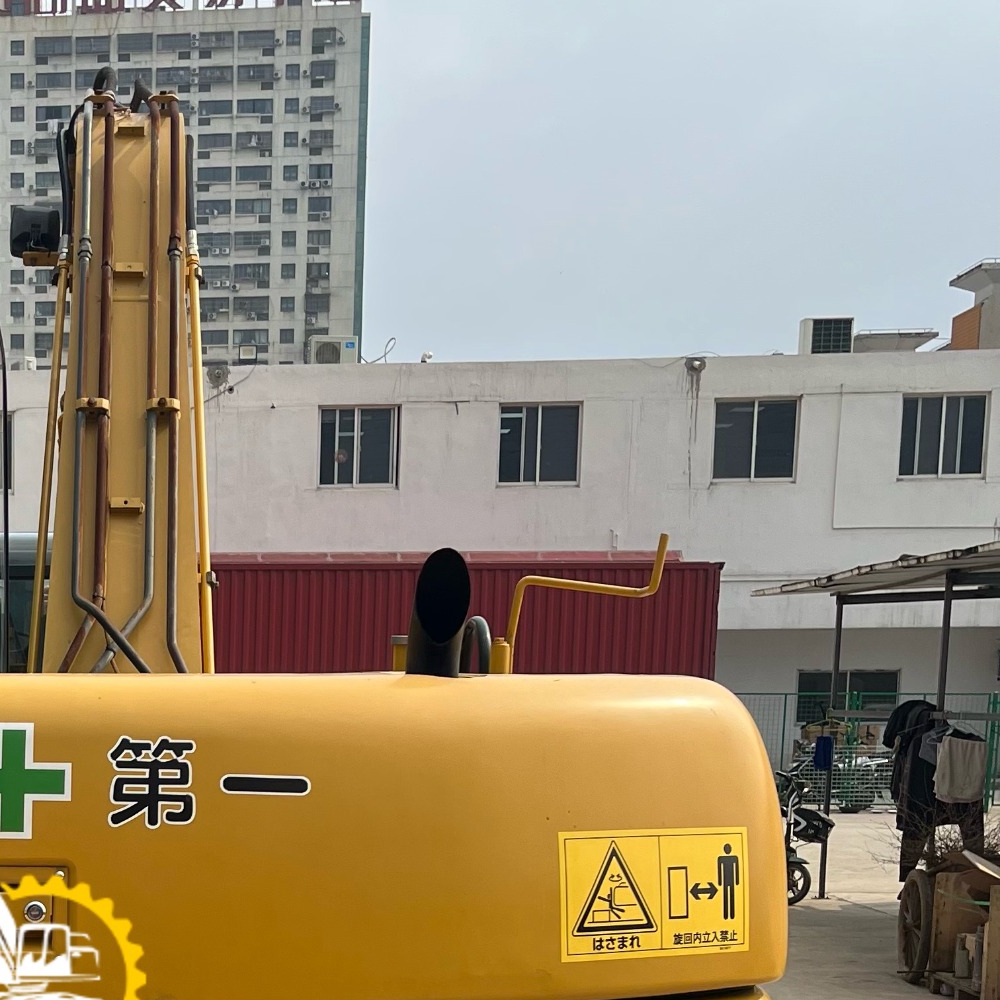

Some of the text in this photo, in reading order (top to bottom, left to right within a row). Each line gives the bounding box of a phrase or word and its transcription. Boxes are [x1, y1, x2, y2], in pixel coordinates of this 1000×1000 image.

[108, 736, 311, 829] 第一
[592, 936, 641, 951] はさまれ
[673, 930, 738, 945] 旋回内立入禁止
